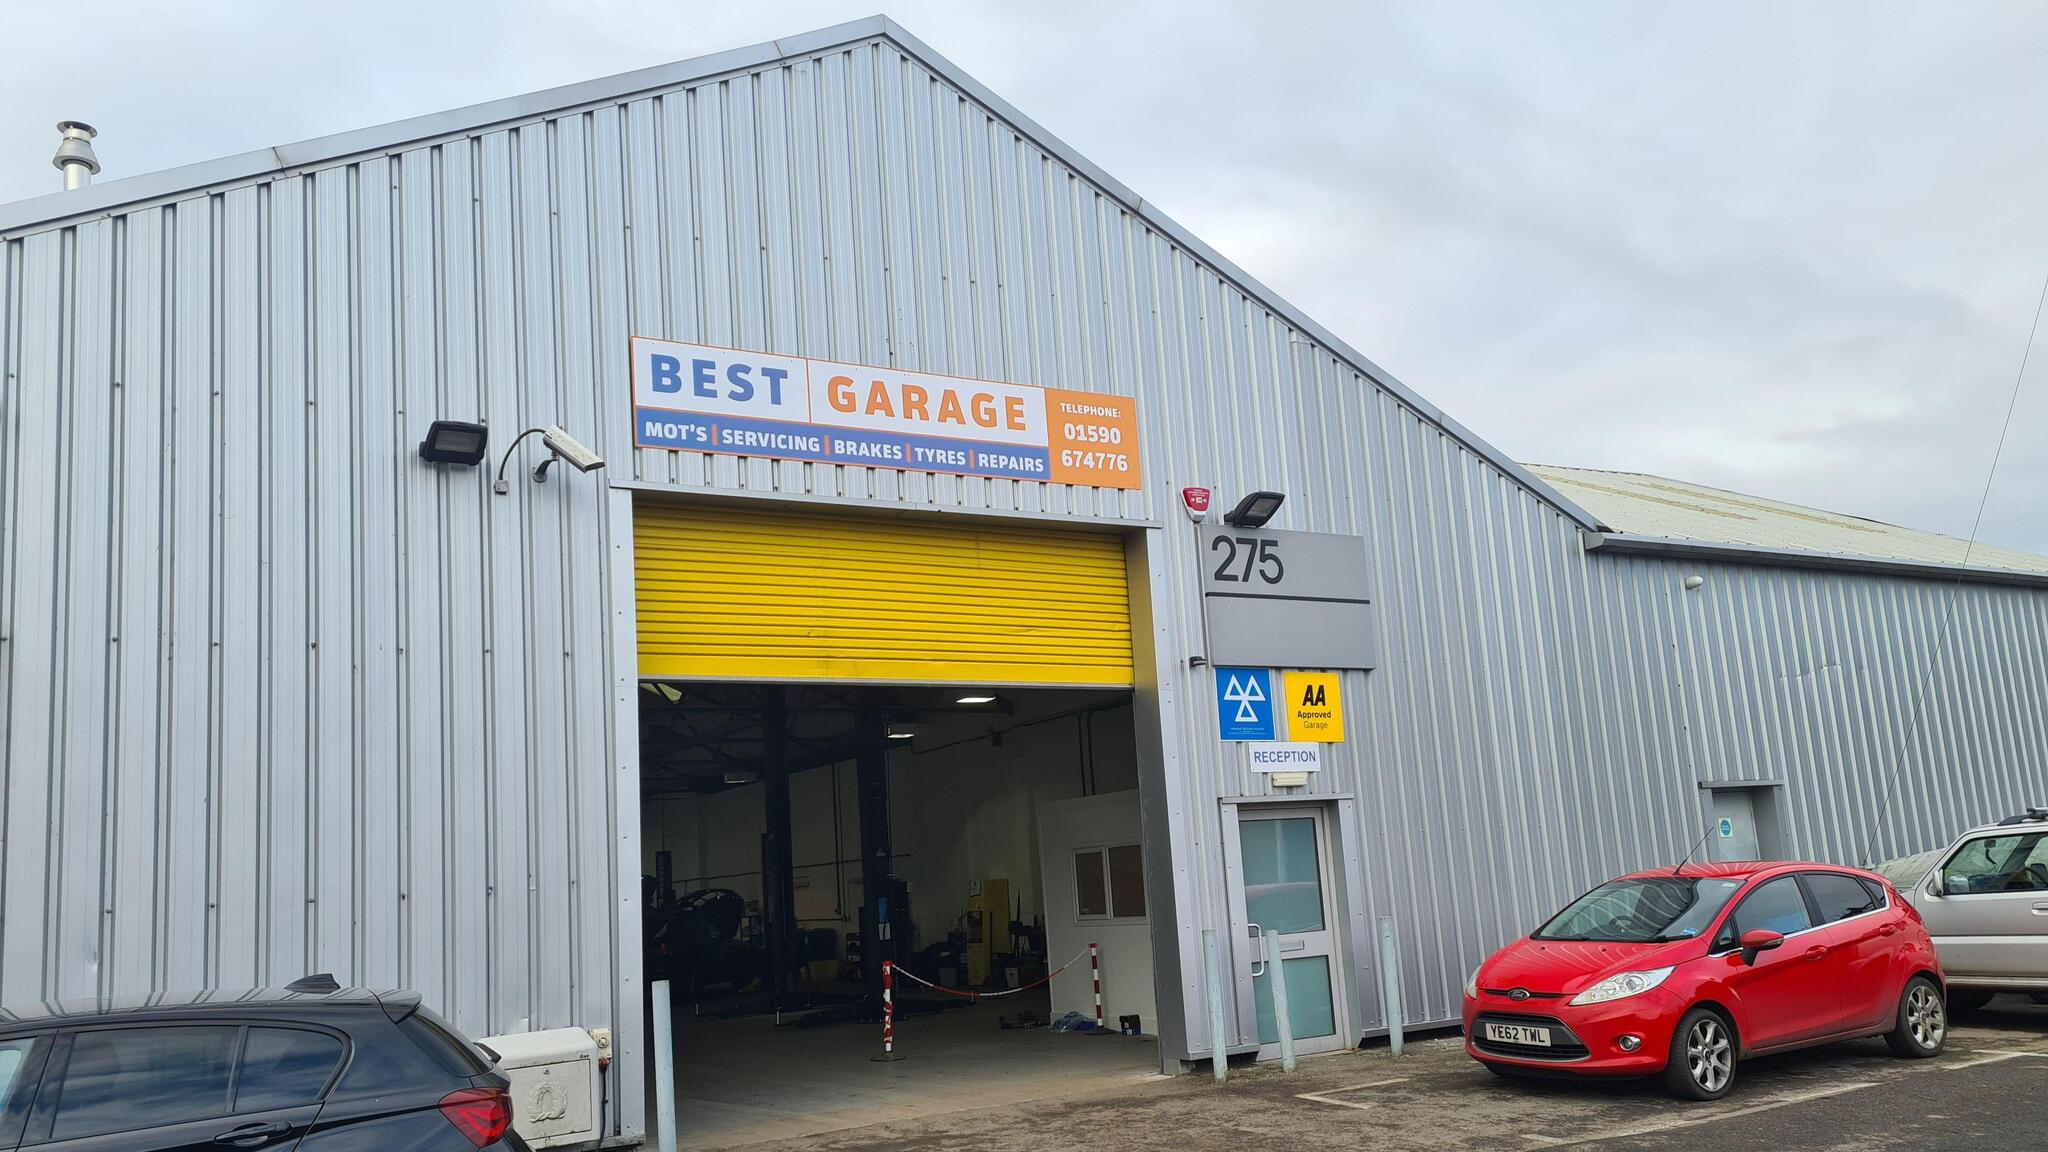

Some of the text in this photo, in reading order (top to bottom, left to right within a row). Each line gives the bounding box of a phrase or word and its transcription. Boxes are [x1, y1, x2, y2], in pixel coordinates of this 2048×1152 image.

[650, 353, 1027, 431] BEST GARAGE
[1060, 402, 1122, 419] TELEPHONE:
[1063, 422, 1122, 445] 01590
[645, 421, 1044, 473] MOT'S SERVICING BRAKES TYRES REPAIRS
[1060, 449, 1129, 472] 674776
[1211, 534, 1284, 585] 275
[1302, 684, 1326, 706] AA
[1297, 710, 1332, 719] Approved
[1303, 721, 1328, 730] Garage
[1253, 750, 1317, 763] RECEPTION
[1490, 1024, 1546, 1043] YE62 TWL
